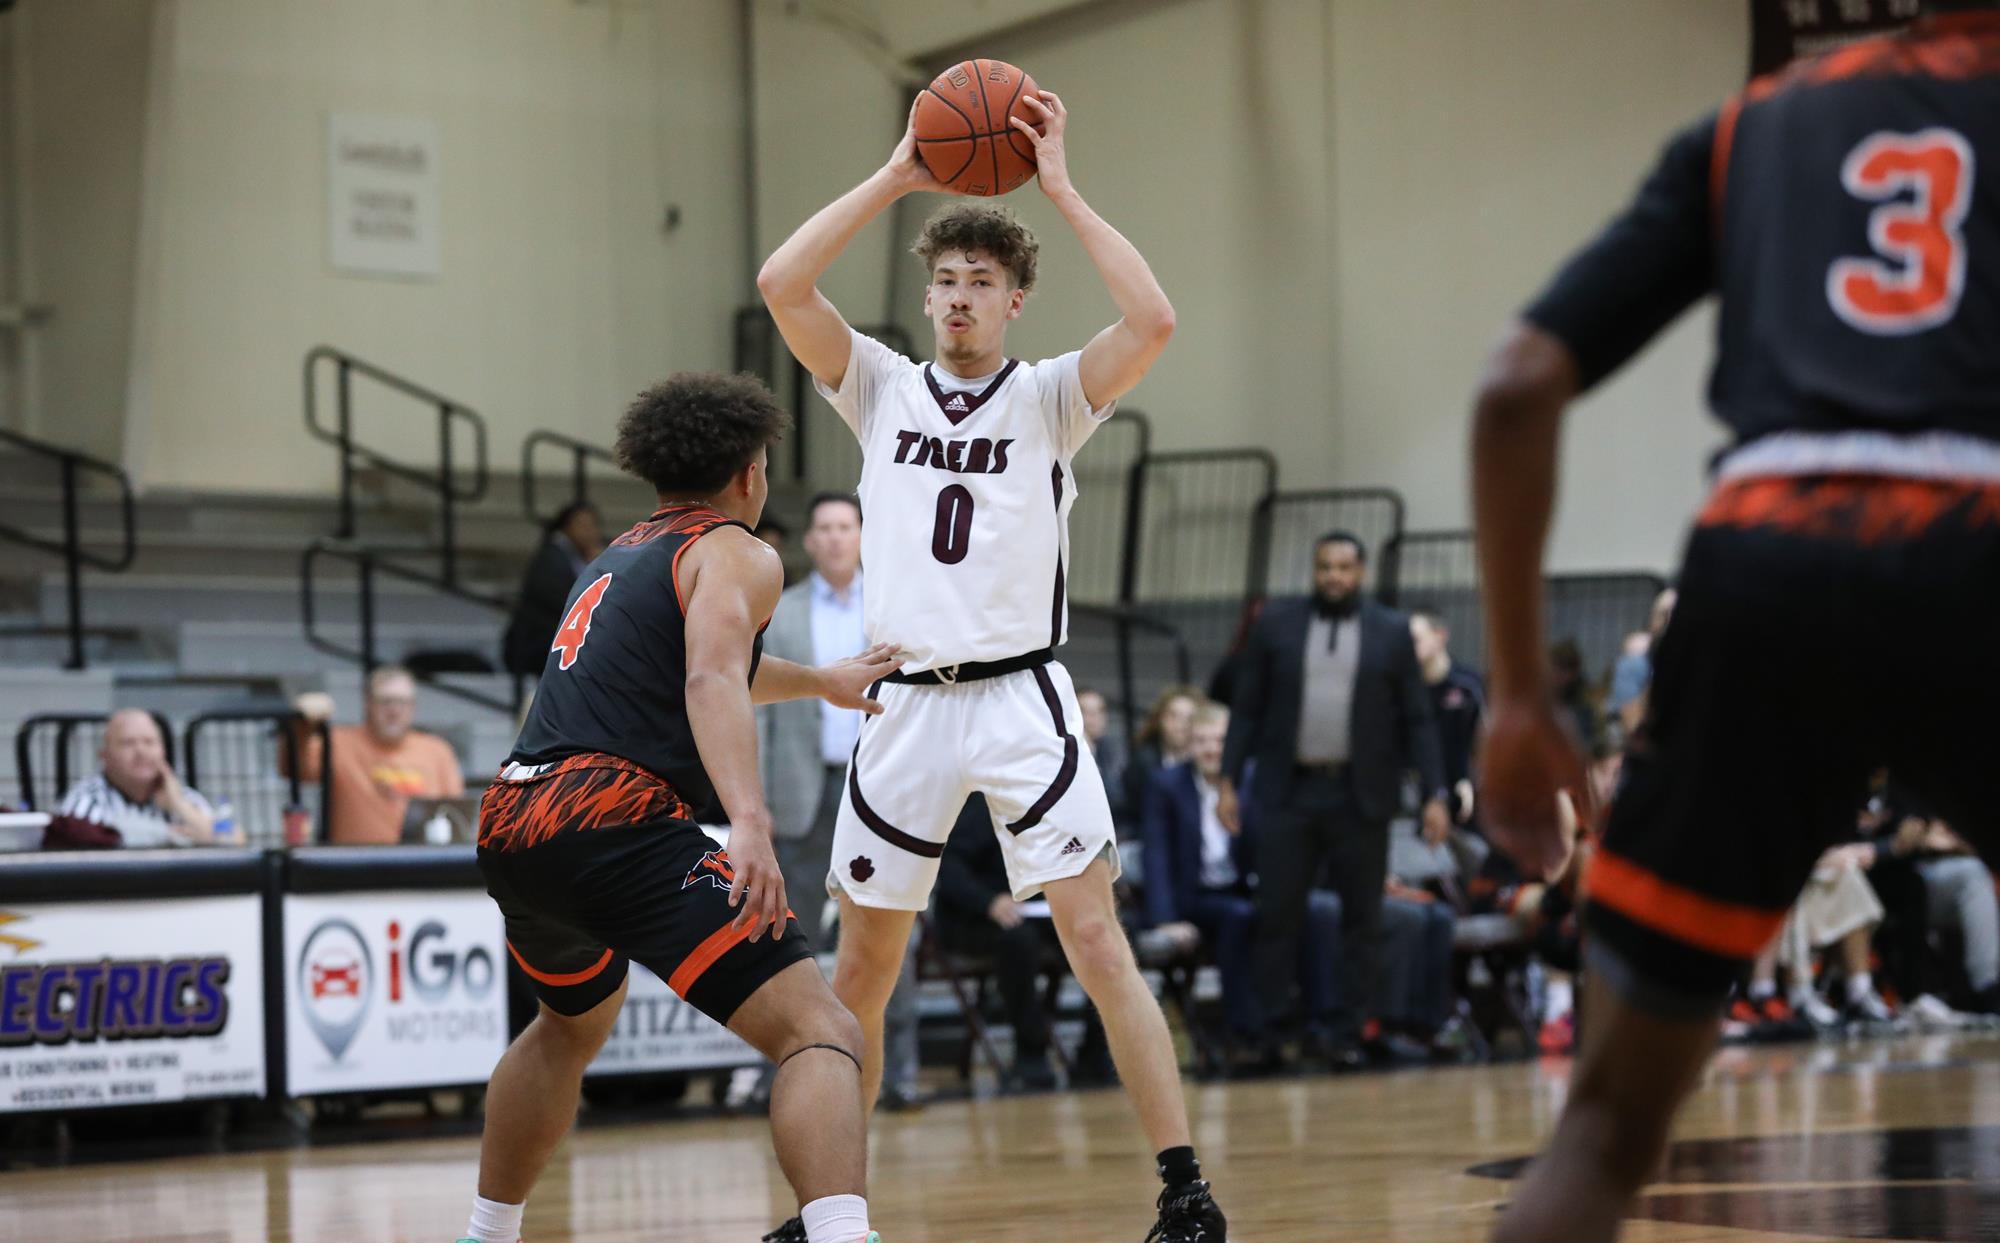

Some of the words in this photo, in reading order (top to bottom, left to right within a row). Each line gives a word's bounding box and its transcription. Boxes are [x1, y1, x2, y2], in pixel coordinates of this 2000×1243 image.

[1825, 126, 1976, 338] 3
[945, 404, 969, 412] adidas
[893, 429, 1016, 474] TIGERS
[931, 484, 974, 565] 0
[551, 572, 613, 670] 4
[388, 919, 494, 1002] iGo
[0, 958, 230, 1046] ECTRICS
[386, 1009, 497, 1042] MOTORS
[611, 996, 718, 1038] TIZE
